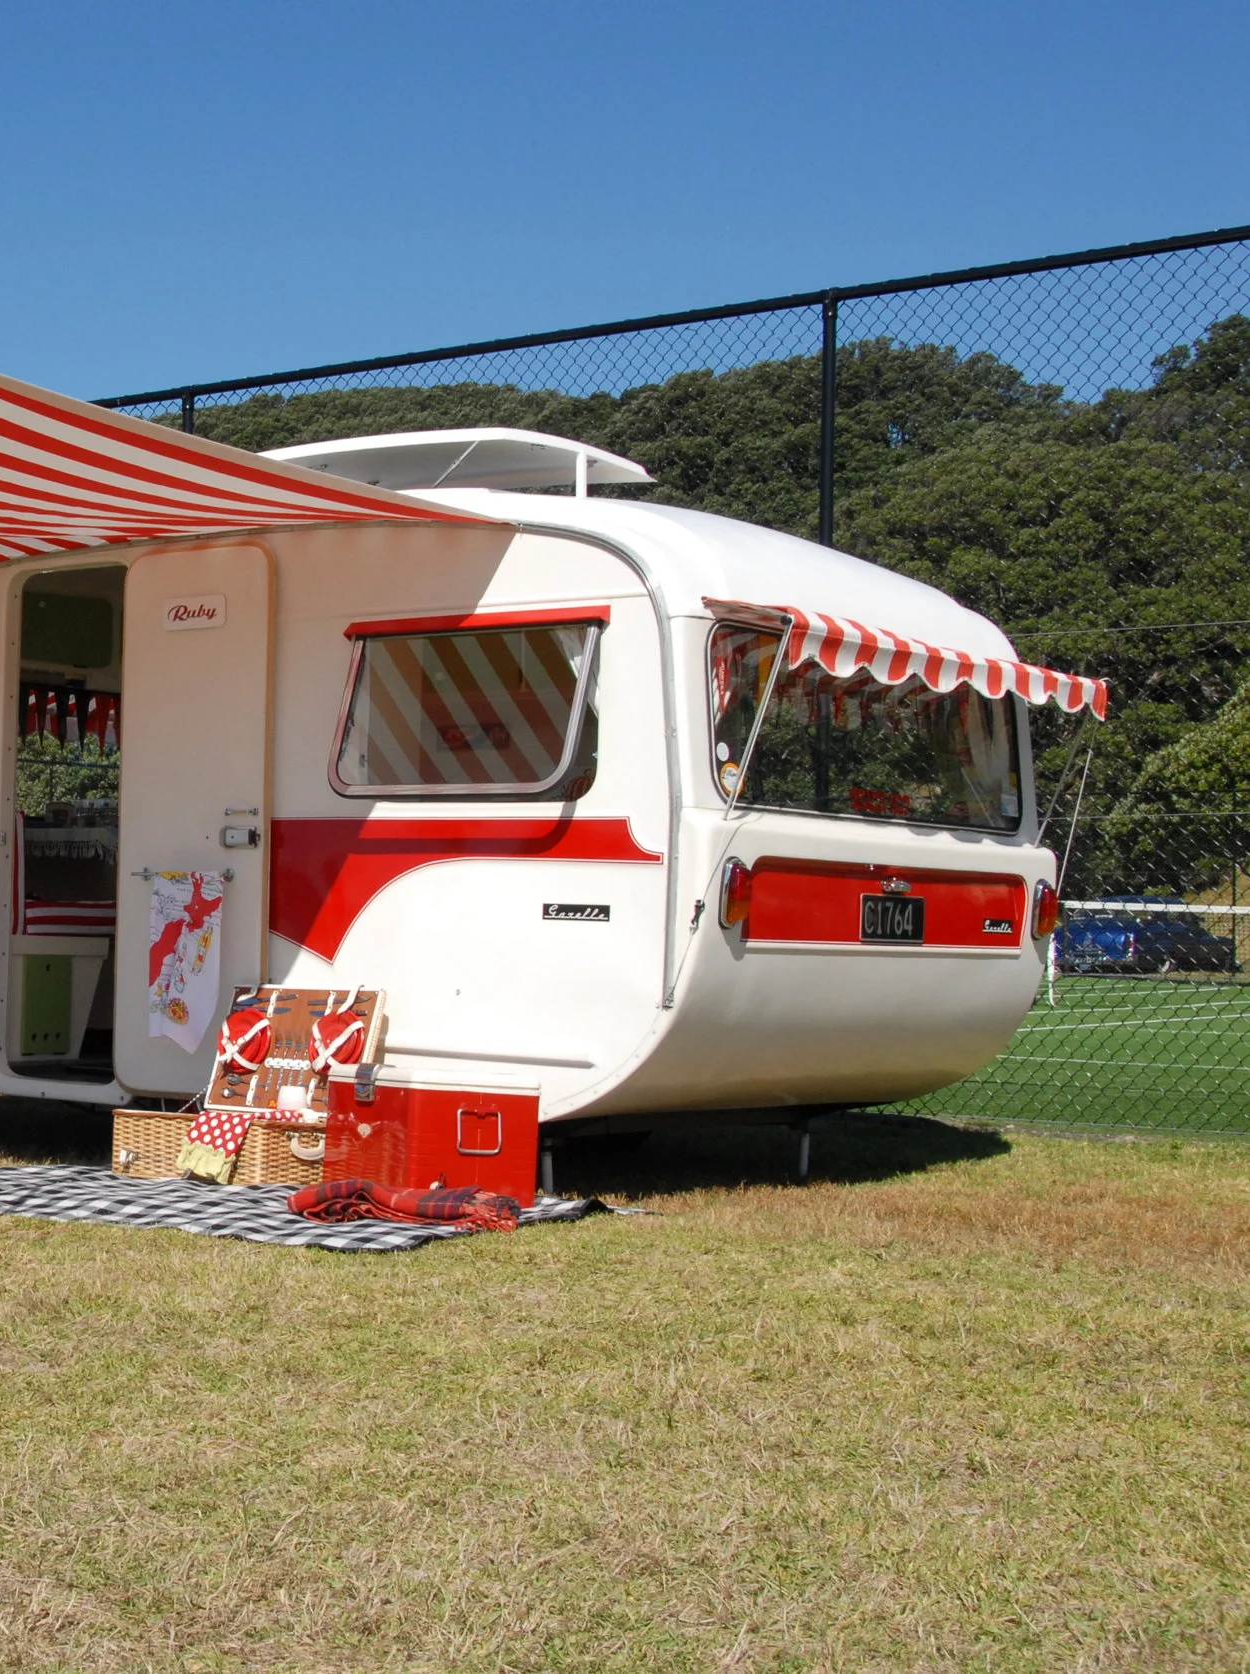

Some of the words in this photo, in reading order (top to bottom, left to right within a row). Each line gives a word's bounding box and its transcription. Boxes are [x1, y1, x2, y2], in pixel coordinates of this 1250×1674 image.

[168, 604, 218, 622] Ruby
[545, 904, 608, 920] Gazelle
[864, 901, 913, 936] C1764
